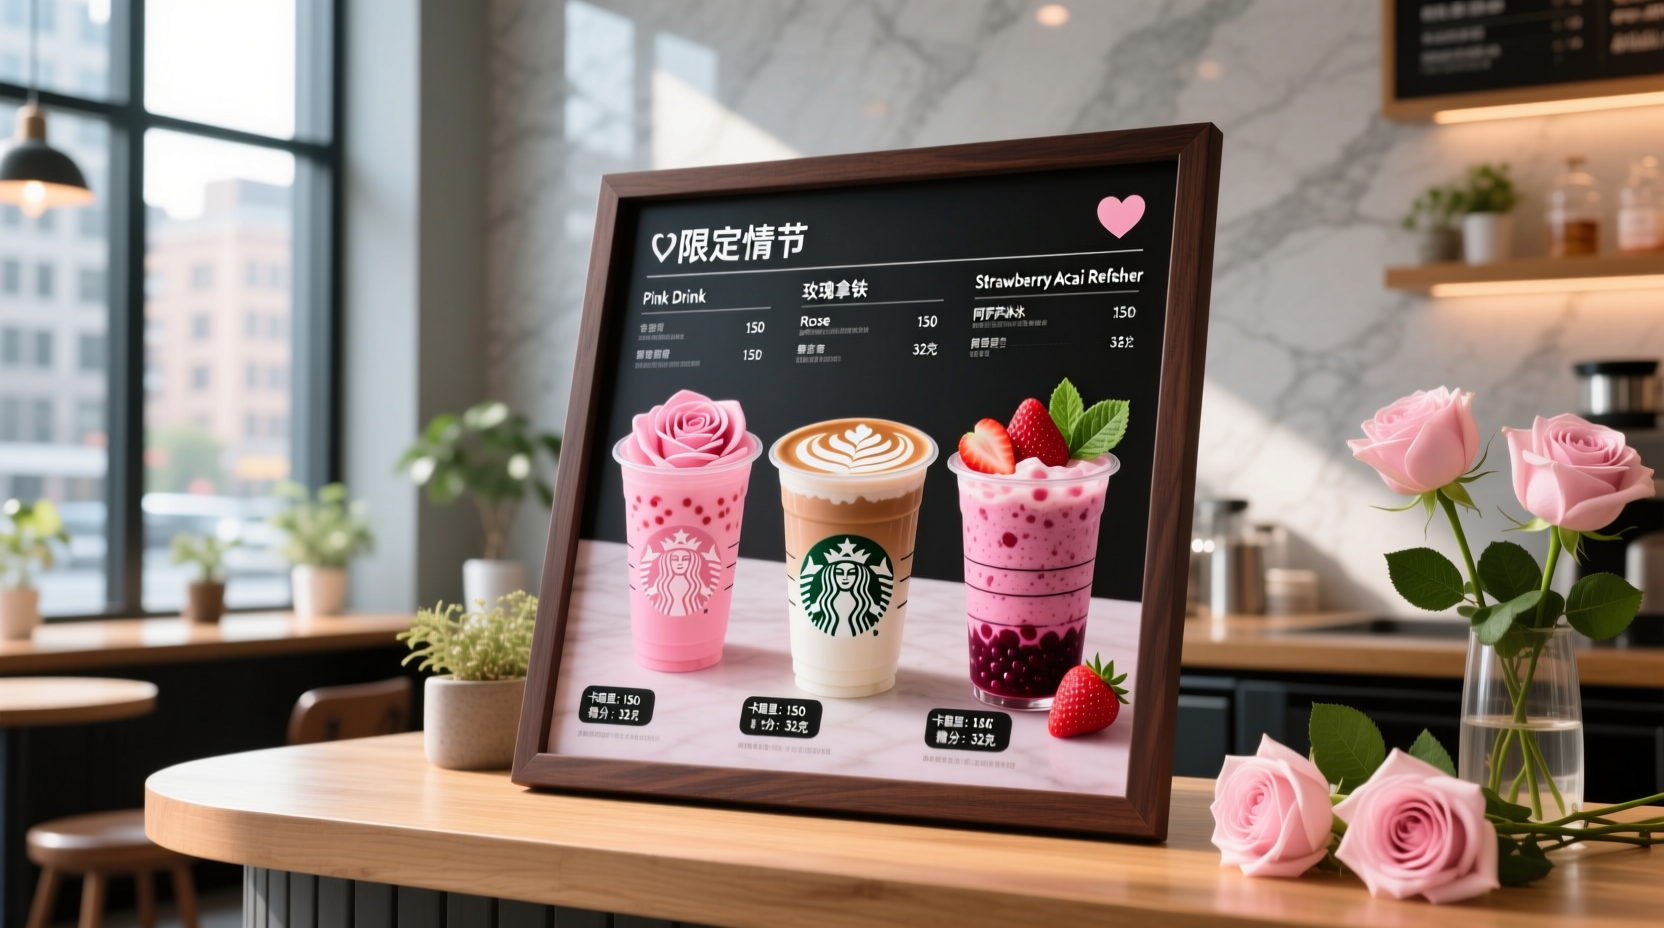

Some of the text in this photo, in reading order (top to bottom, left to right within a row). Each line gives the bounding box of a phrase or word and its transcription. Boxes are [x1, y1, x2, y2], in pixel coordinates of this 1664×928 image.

[677, 222, 809, 265] 限定情节
[974, 271, 1053, 291] Strawberry
[642, 287, 707, 306] Pink Drink
[1112, 305, 1137, 320] 150
[745, 320, 766, 334] 150
[799, 315, 831, 328] Rose
[917, 314, 939, 328] 150
[742, 348, 763, 361] 150
